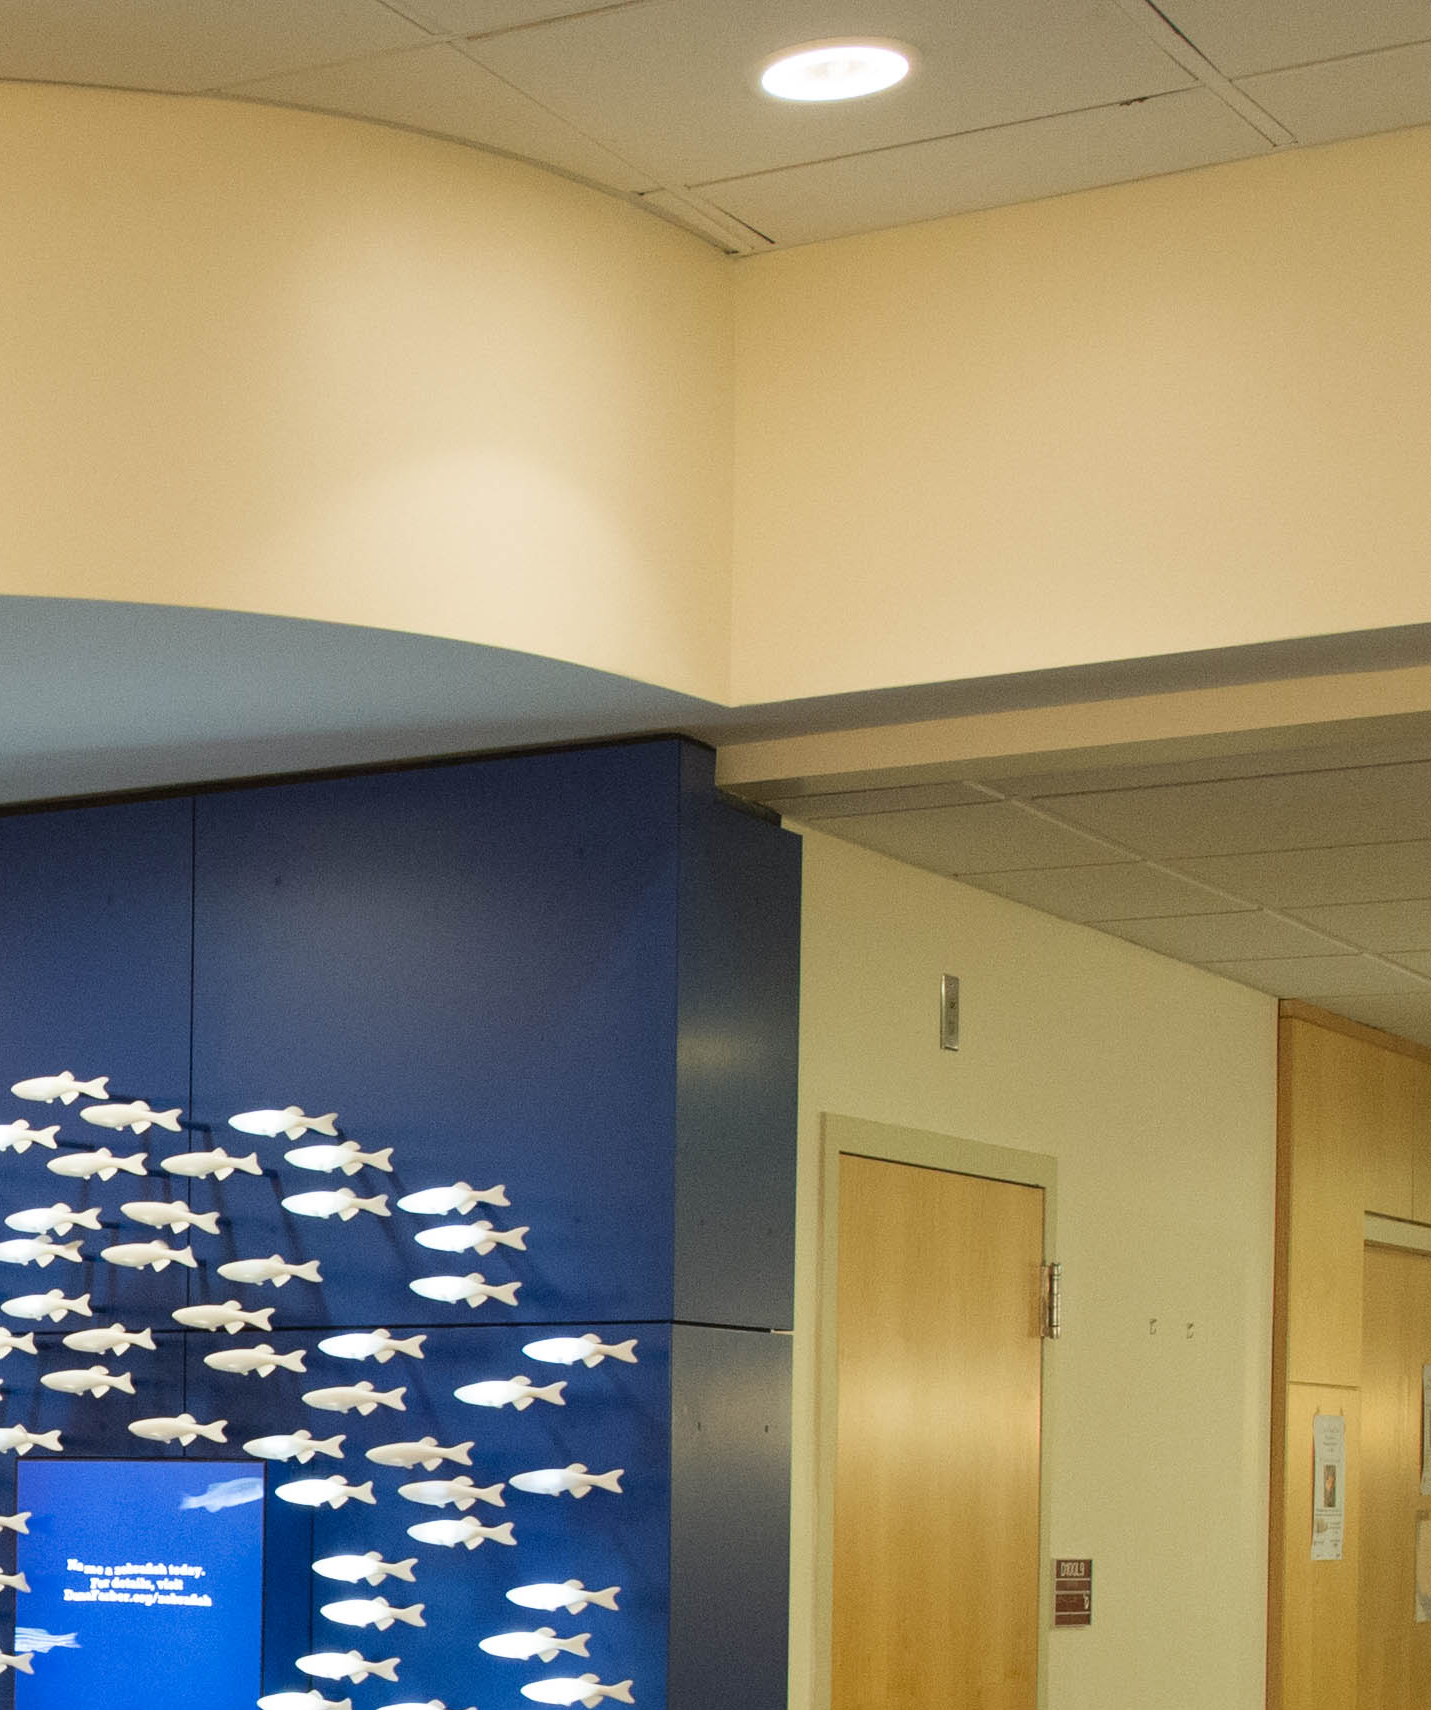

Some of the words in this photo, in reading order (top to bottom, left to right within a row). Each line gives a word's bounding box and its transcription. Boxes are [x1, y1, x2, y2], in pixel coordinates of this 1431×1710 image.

[66, 1558, 104, 1576] Name
[104, 1566, 114, 1577] a
[168, 1563, 207, 1579] today.
[90, 1577, 111, 1590] For
[156, 1577, 184, 1591] visit
